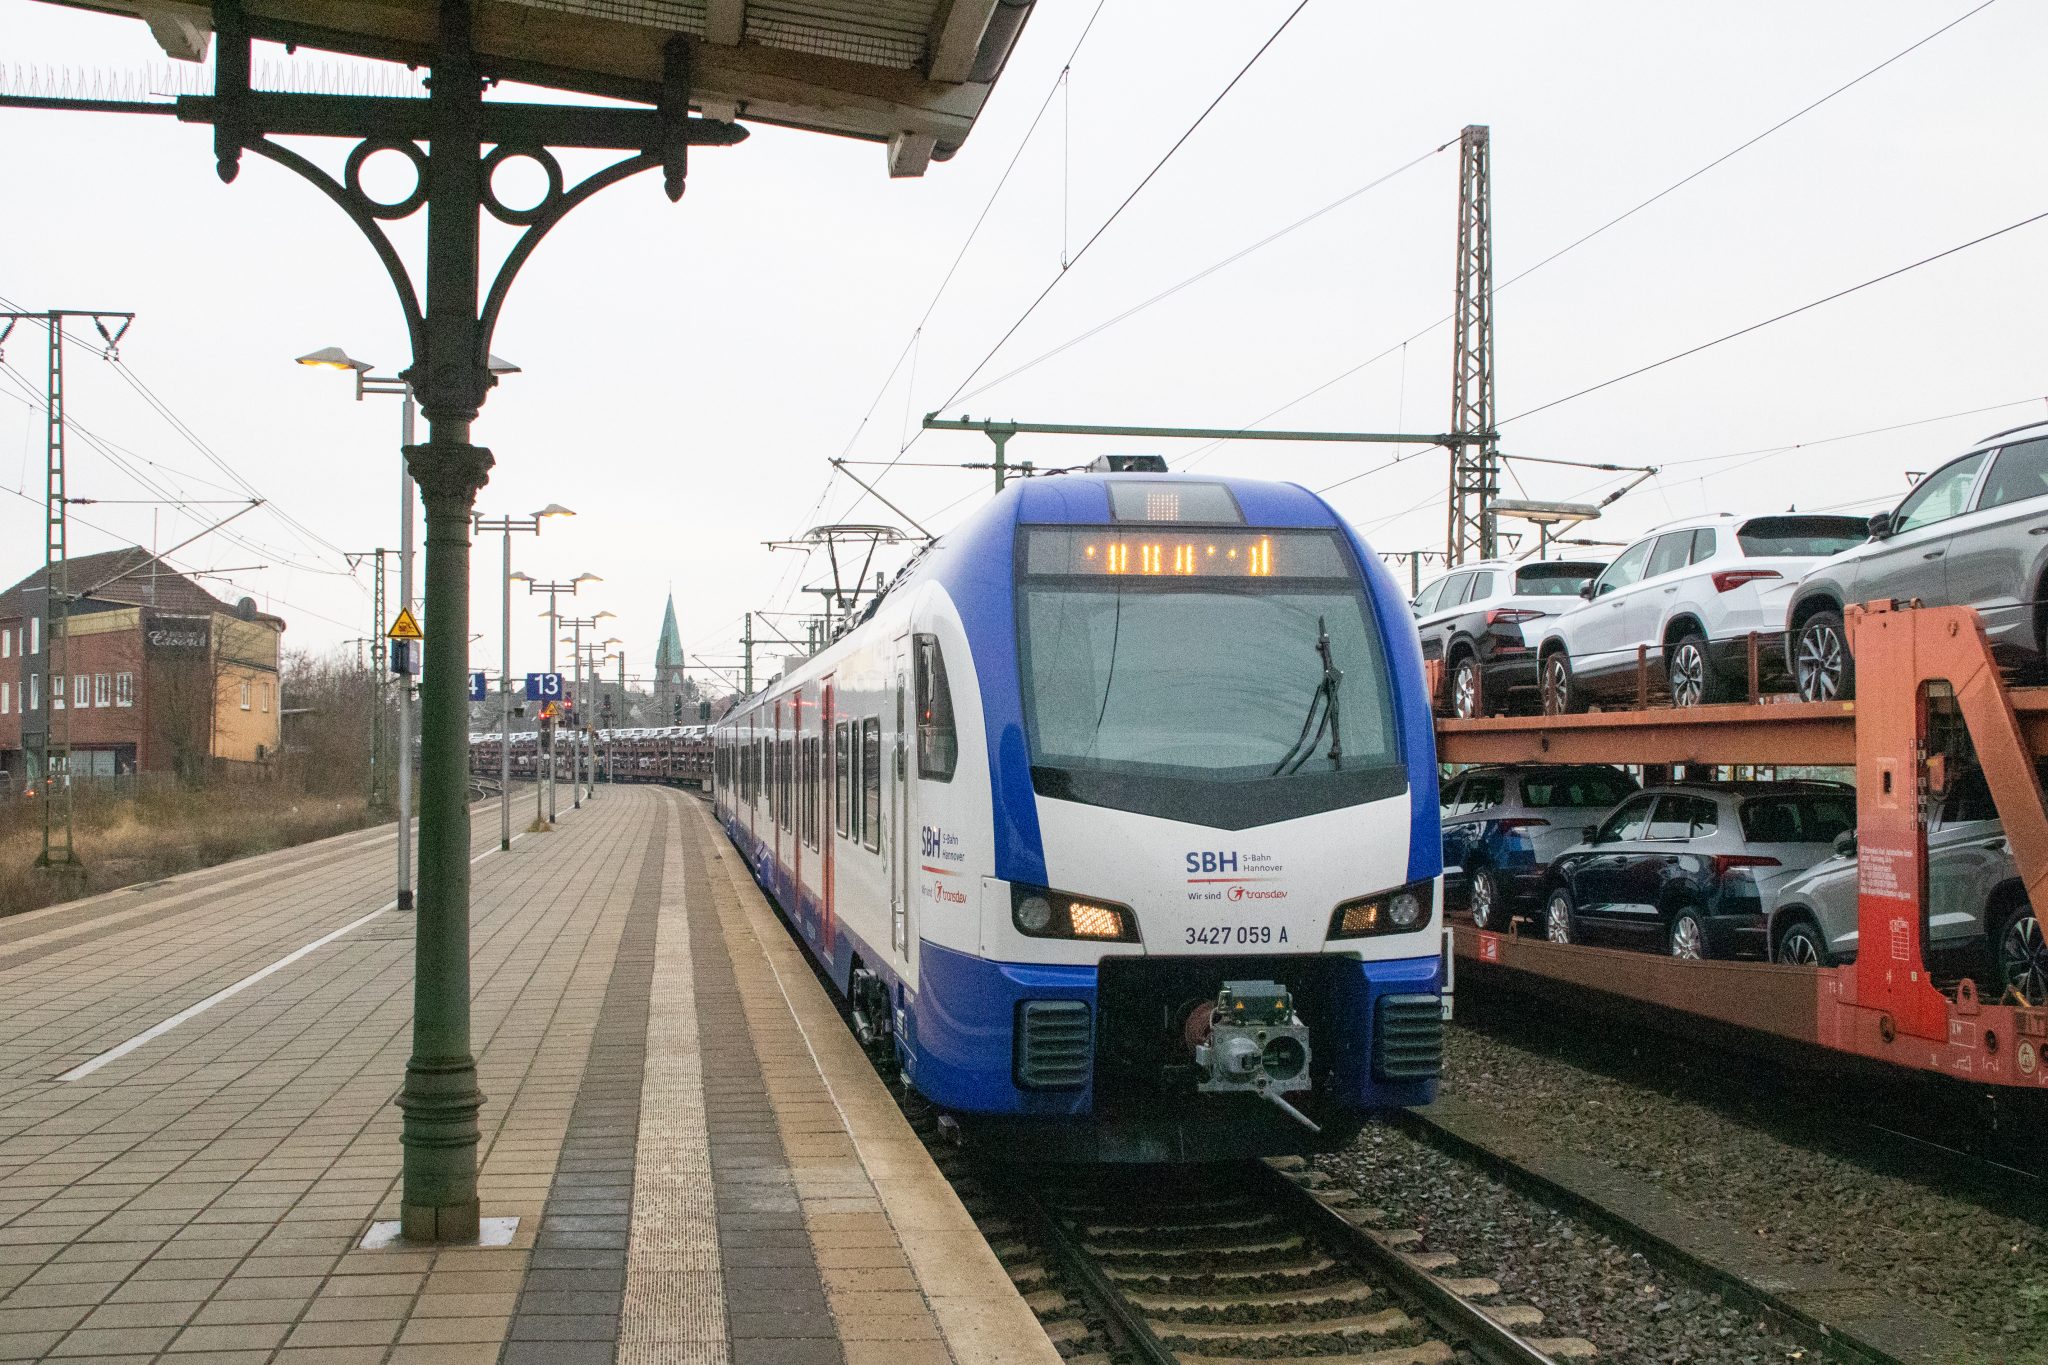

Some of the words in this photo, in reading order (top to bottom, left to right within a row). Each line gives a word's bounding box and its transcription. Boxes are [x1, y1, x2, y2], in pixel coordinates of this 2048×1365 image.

[534, 674, 559, 695] 13
[922, 825, 941, 858] SBH
[1186, 851, 1238, 873] SBH
[1243, 853, 1271, 862] S-Bahn
[1243, 864, 1283, 872] Hannover
[942, 889, 967, 904] transdev
[1188, 892, 1202, 900] Wir
[1204, 891, 1222, 900] sind
[1246, 889, 1288, 899] transdev
[1185, 927, 1232, 945] 3427
[1237, 926, 1271, 944] 059
[1279, 926, 1288, 943] A
